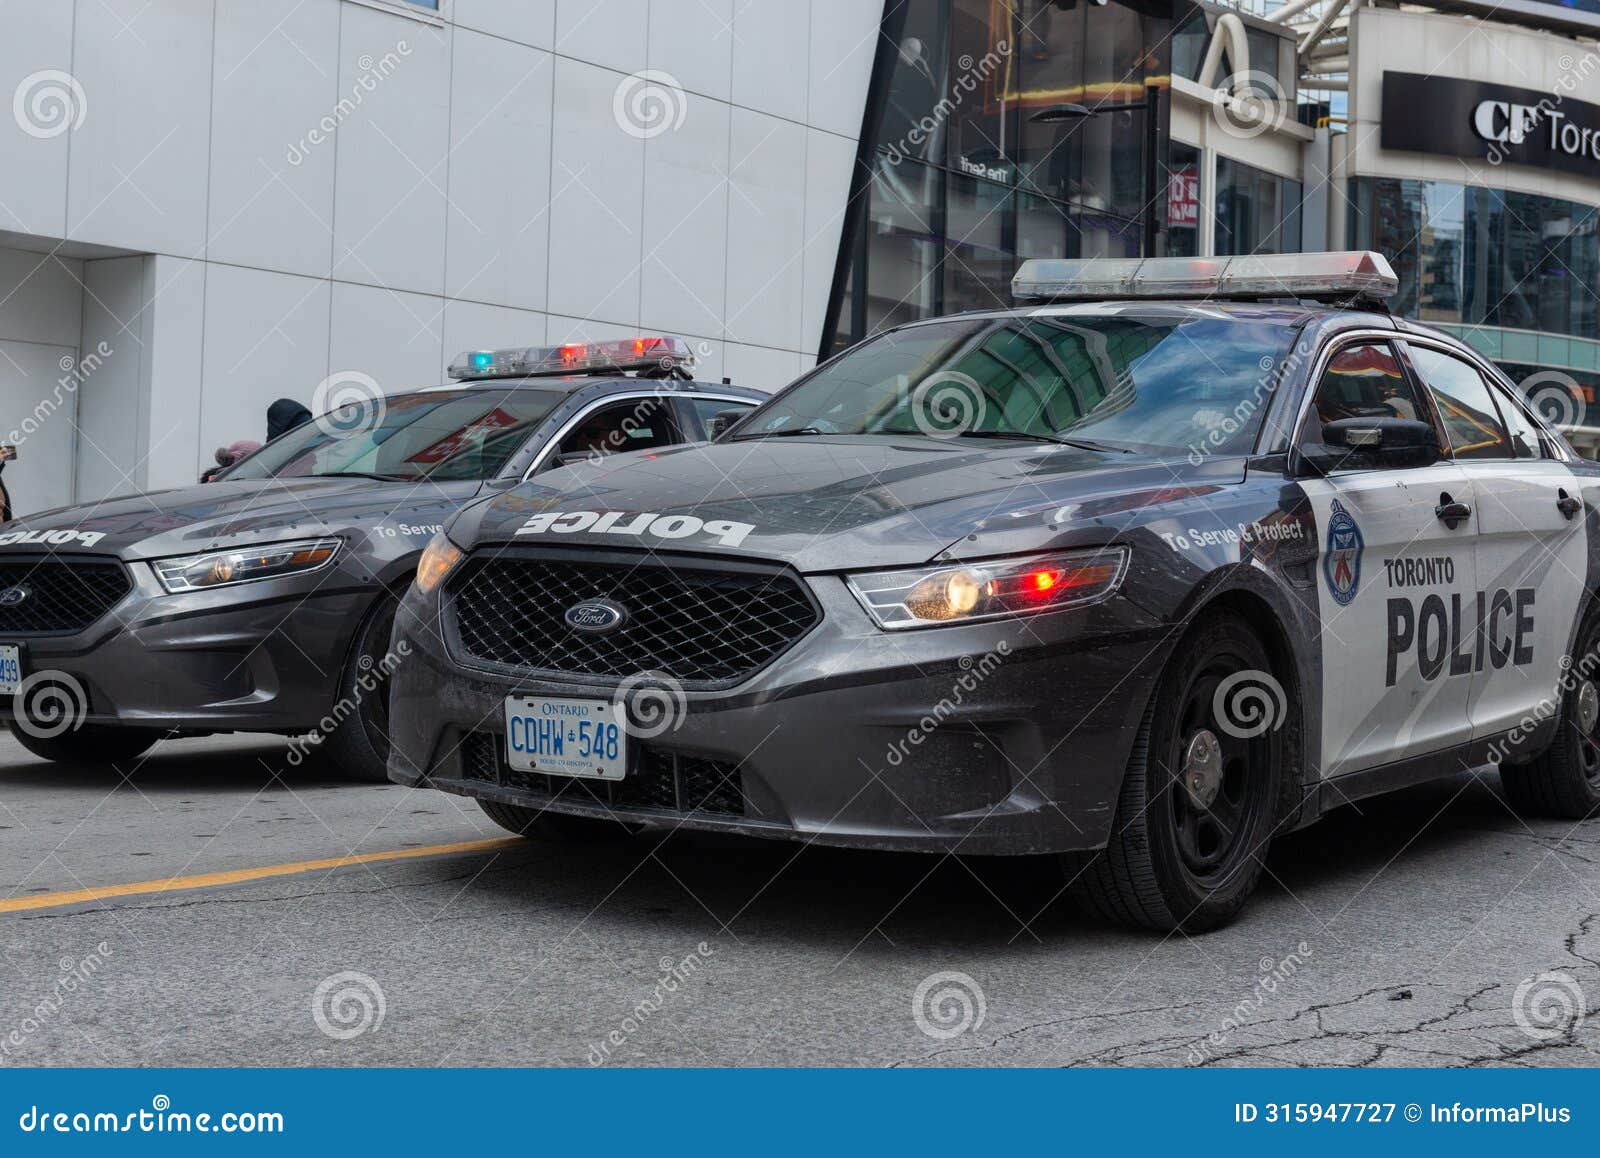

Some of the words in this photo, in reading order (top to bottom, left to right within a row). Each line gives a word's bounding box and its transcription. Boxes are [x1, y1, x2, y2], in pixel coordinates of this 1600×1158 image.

[373, 526, 396, 538] To
[1160, 532, 1190, 551] To
[1188, 528, 1240, 547] Serve
[1238, 522, 1252, 541] &
[1251, 519, 1304, 541] Protect
[1384, 557, 1455, 587] TORONTO
[574, 607, 607, 624] Ford
[1385, 588, 1535, 687] POLICE
[542, 703, 589, 716] ONTARIO
[579, 720, 619, 760] 548
